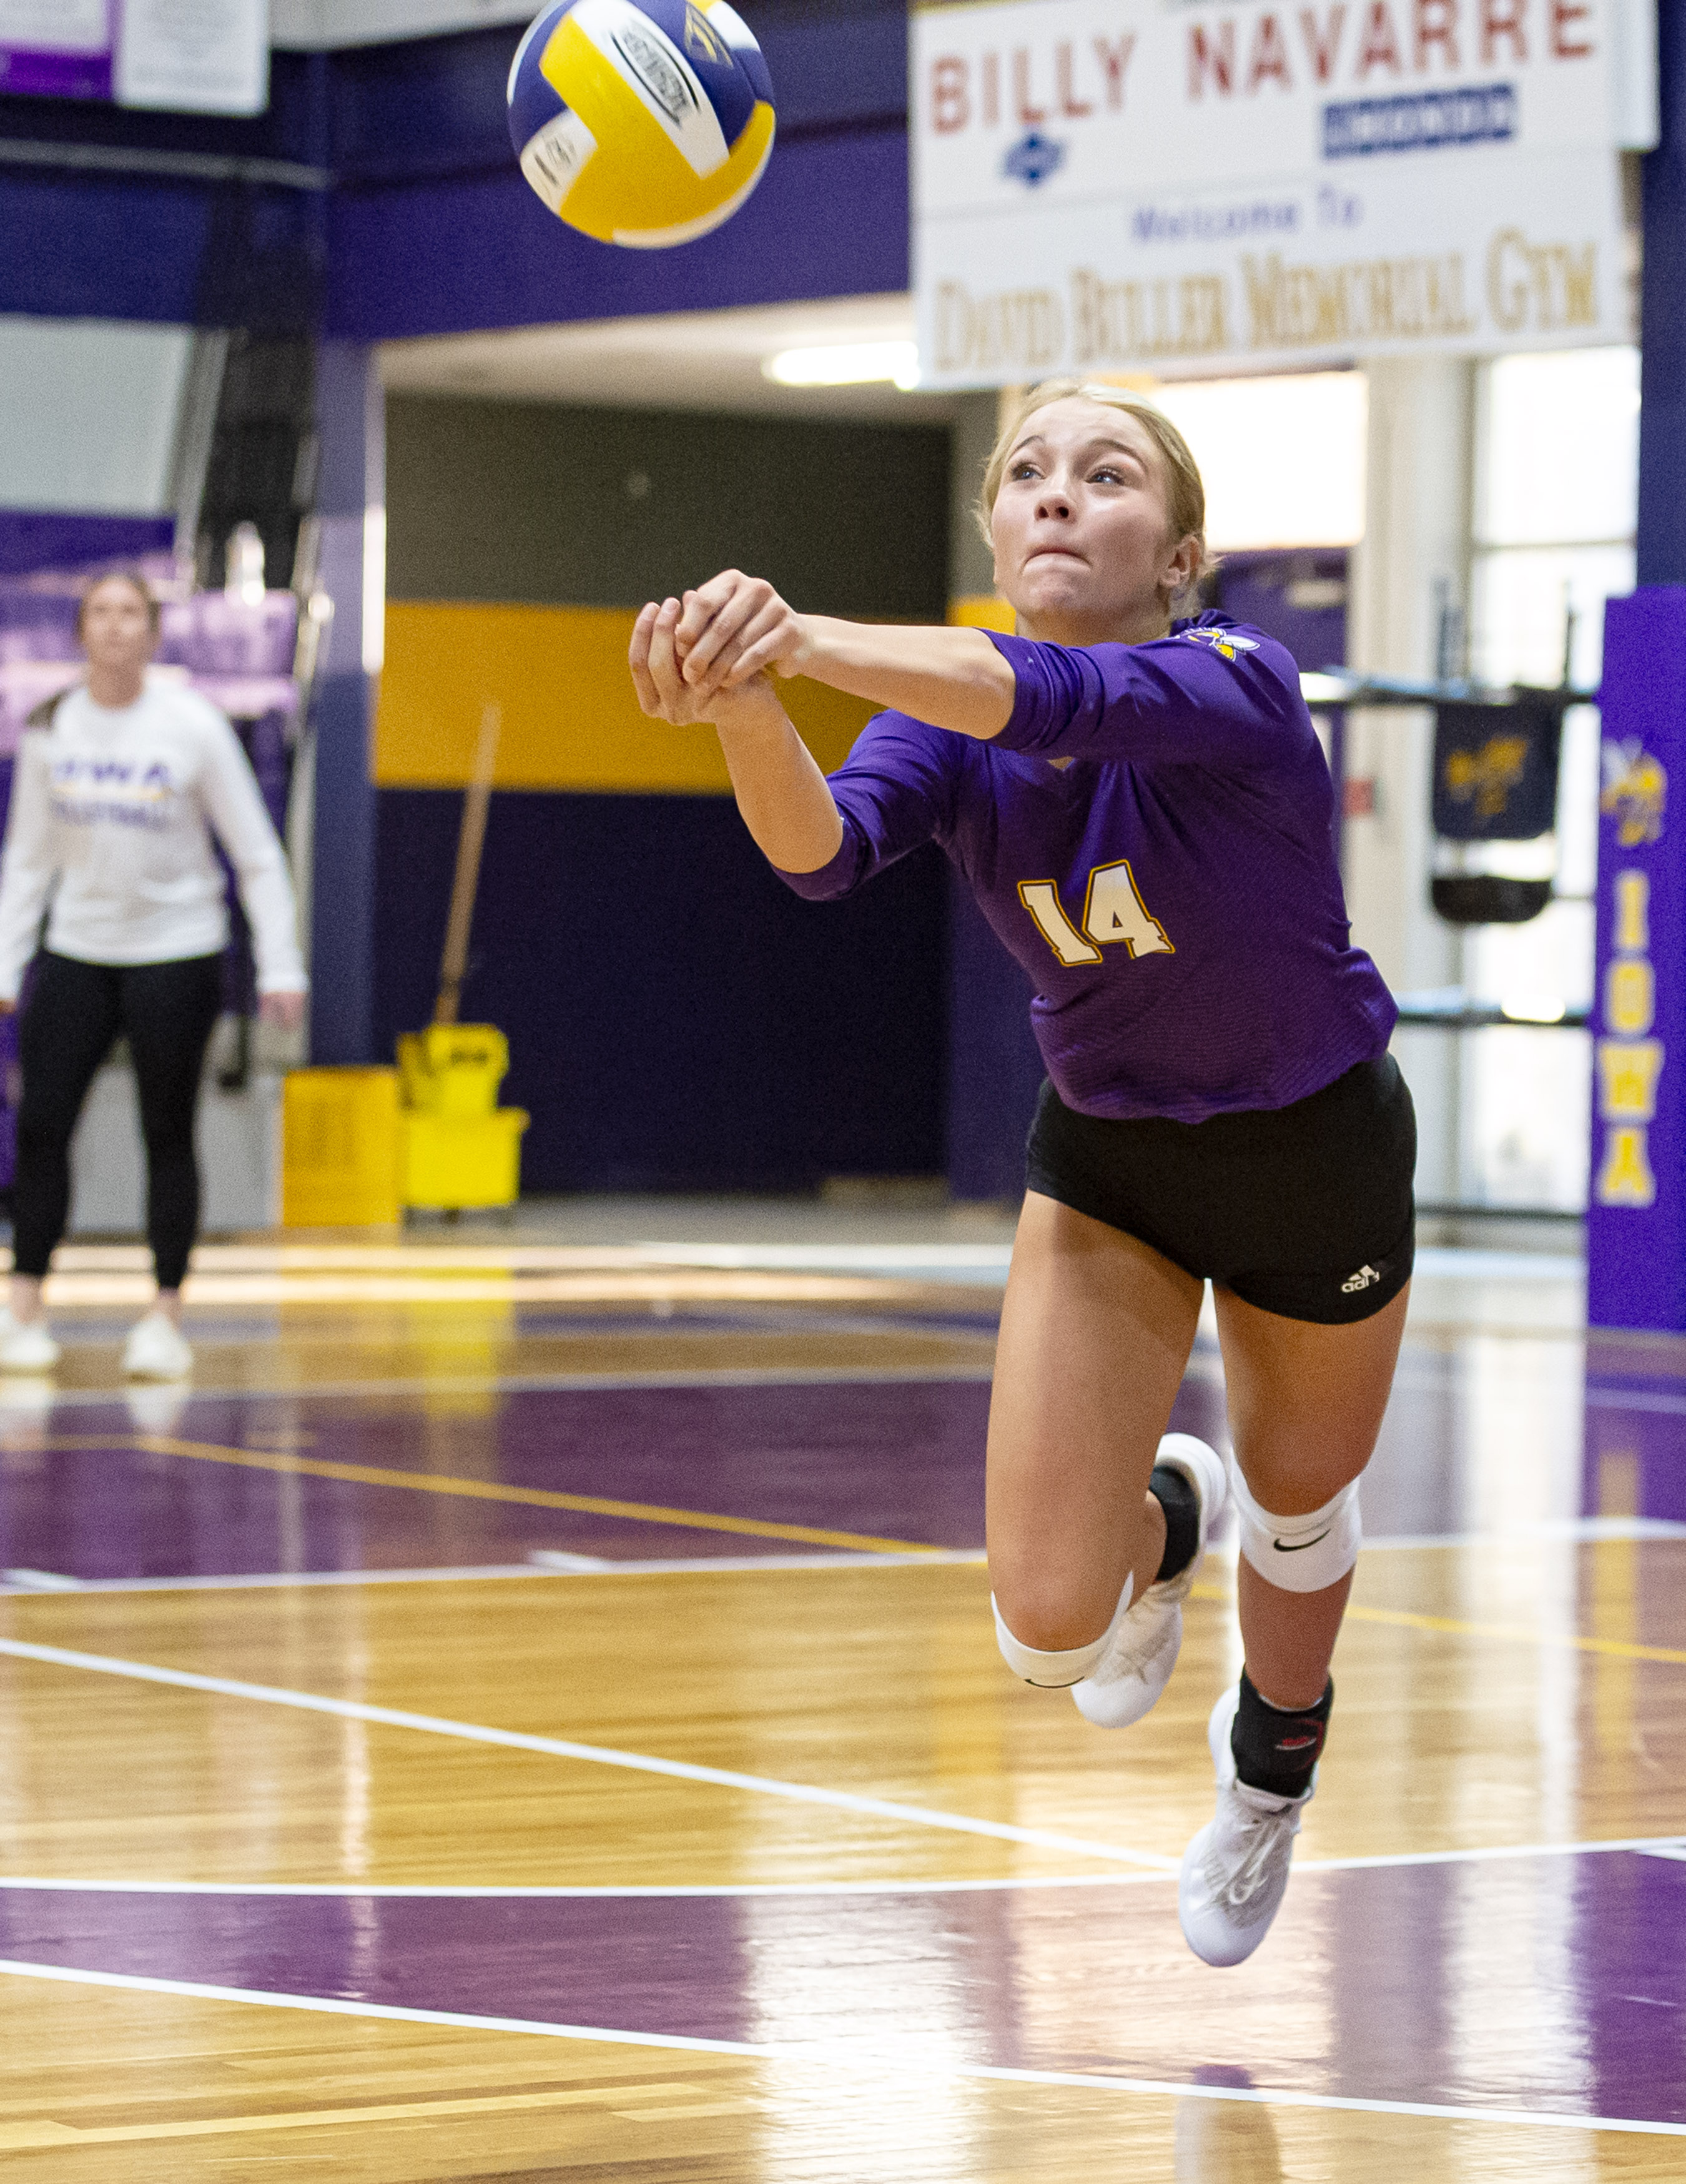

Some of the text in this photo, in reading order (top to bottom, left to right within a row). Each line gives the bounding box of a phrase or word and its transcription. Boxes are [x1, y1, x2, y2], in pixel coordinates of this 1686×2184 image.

[930, 0, 1595, 136] BILLY NAVARRE
[1131, 200, 1300, 244] Welcome
[1241, 251, 1475, 350] MEMORIAL
[1489, 225, 1599, 332] GYM
[1018, 859, 1175, 967] 14
[1597, 871, 1665, 1207] IOWA
